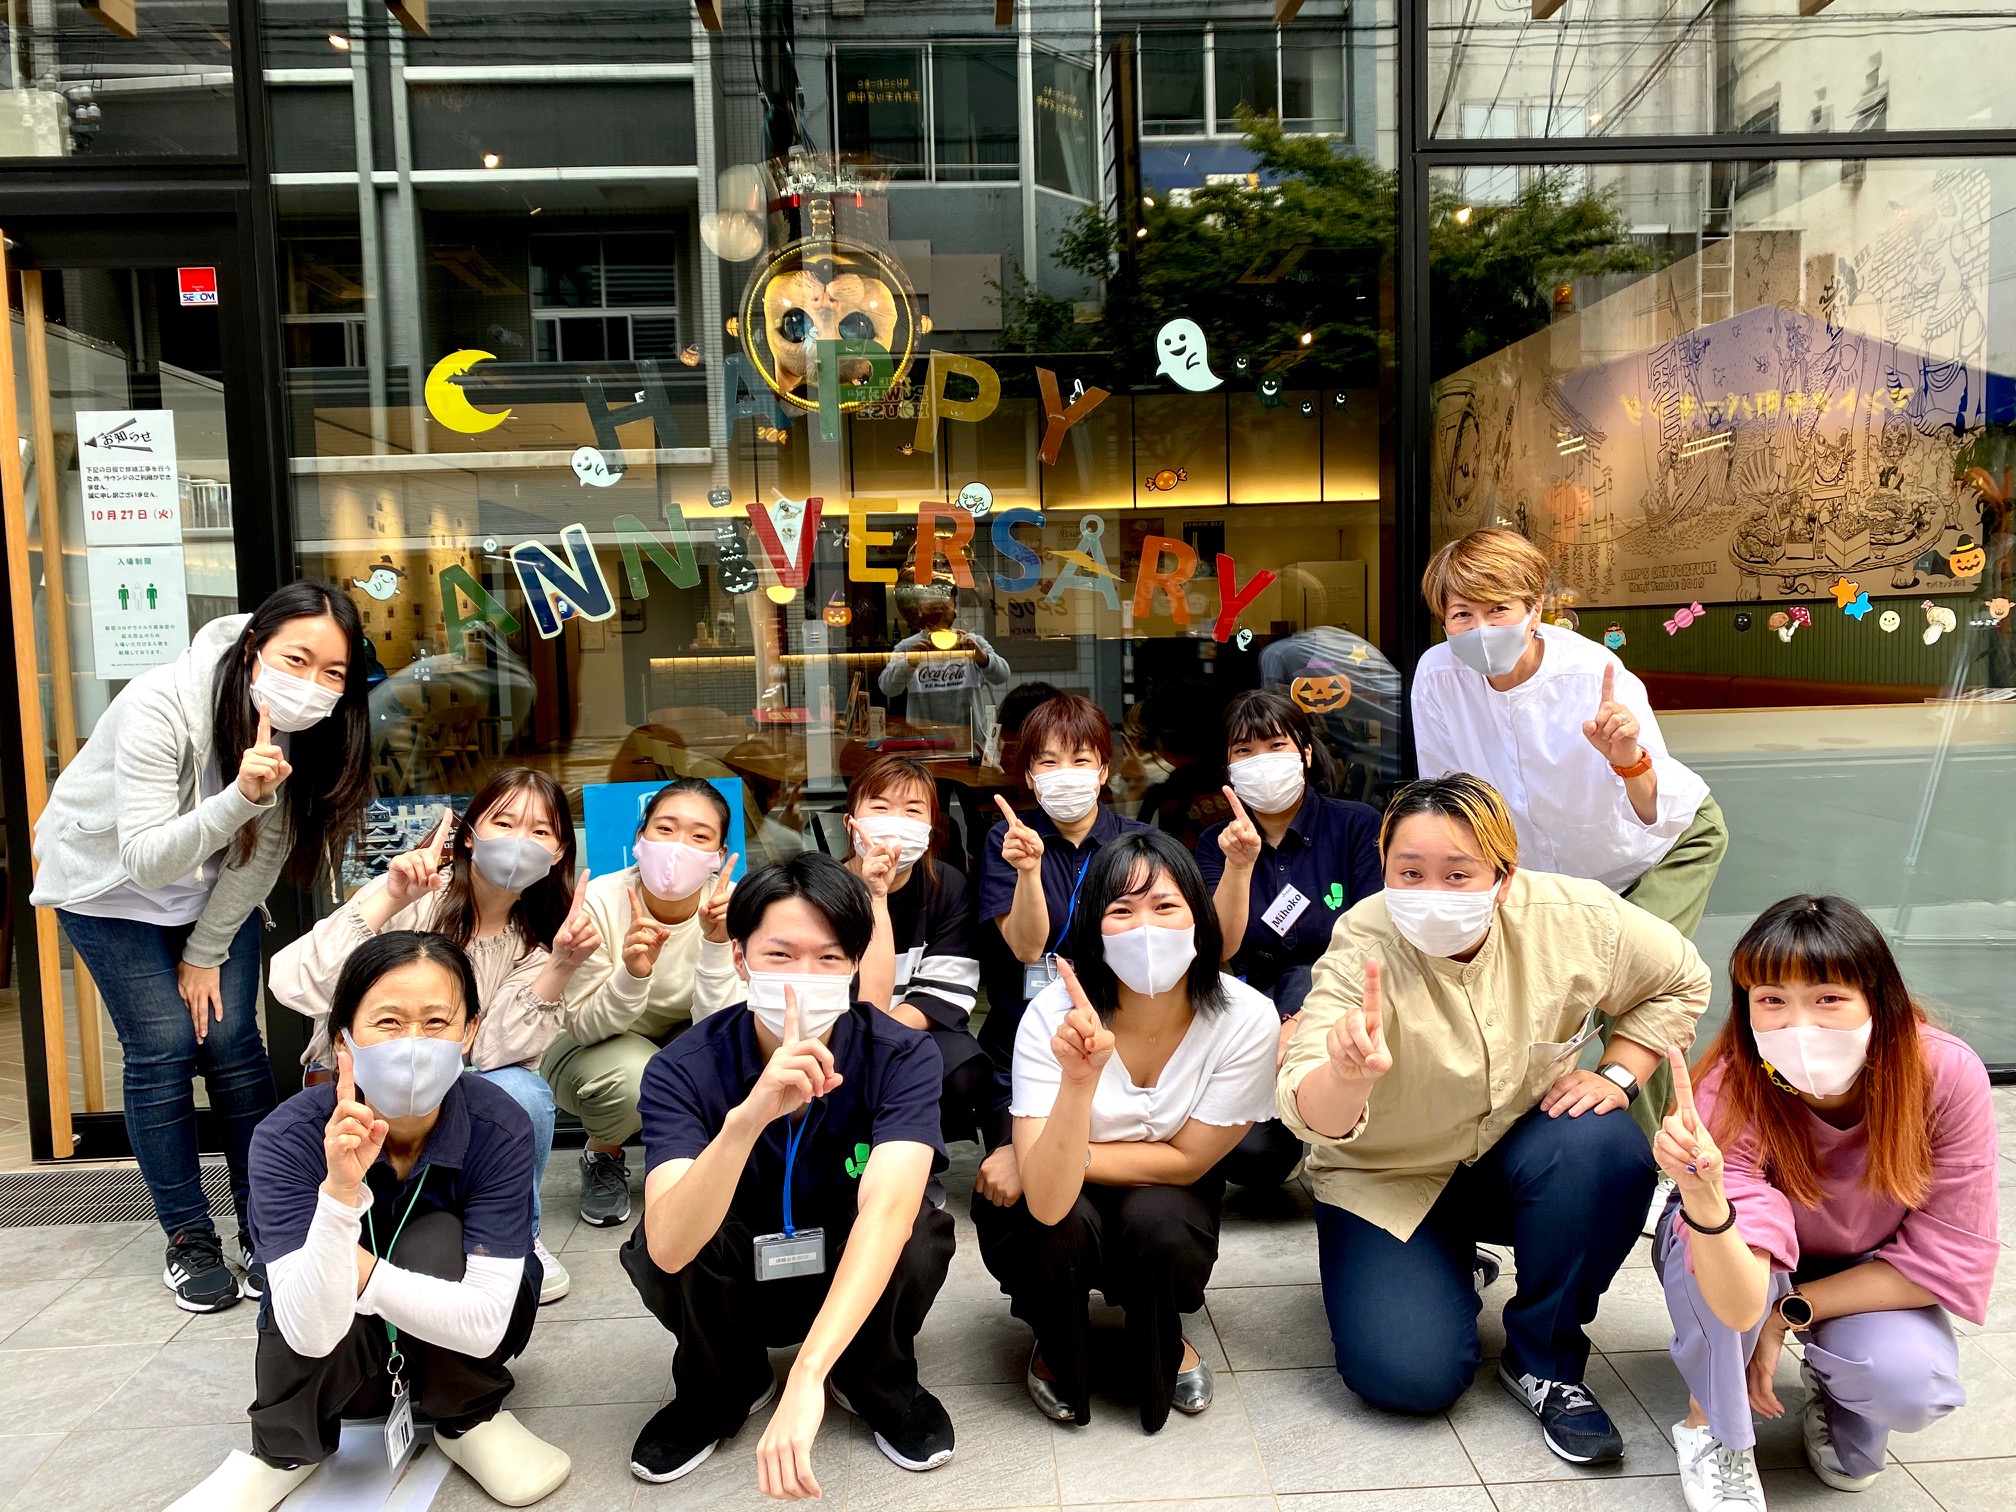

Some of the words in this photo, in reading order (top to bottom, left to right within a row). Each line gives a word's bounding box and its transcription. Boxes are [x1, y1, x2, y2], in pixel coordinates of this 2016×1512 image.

[182, 292, 215, 302] SECOM
[576, 337, 1111, 474] HAPPY
[101, 430, 152, 446] お知らせ
[117, 557, 152, 566] 入場制限
[1270, 893, 1302, 929] Mihoko
